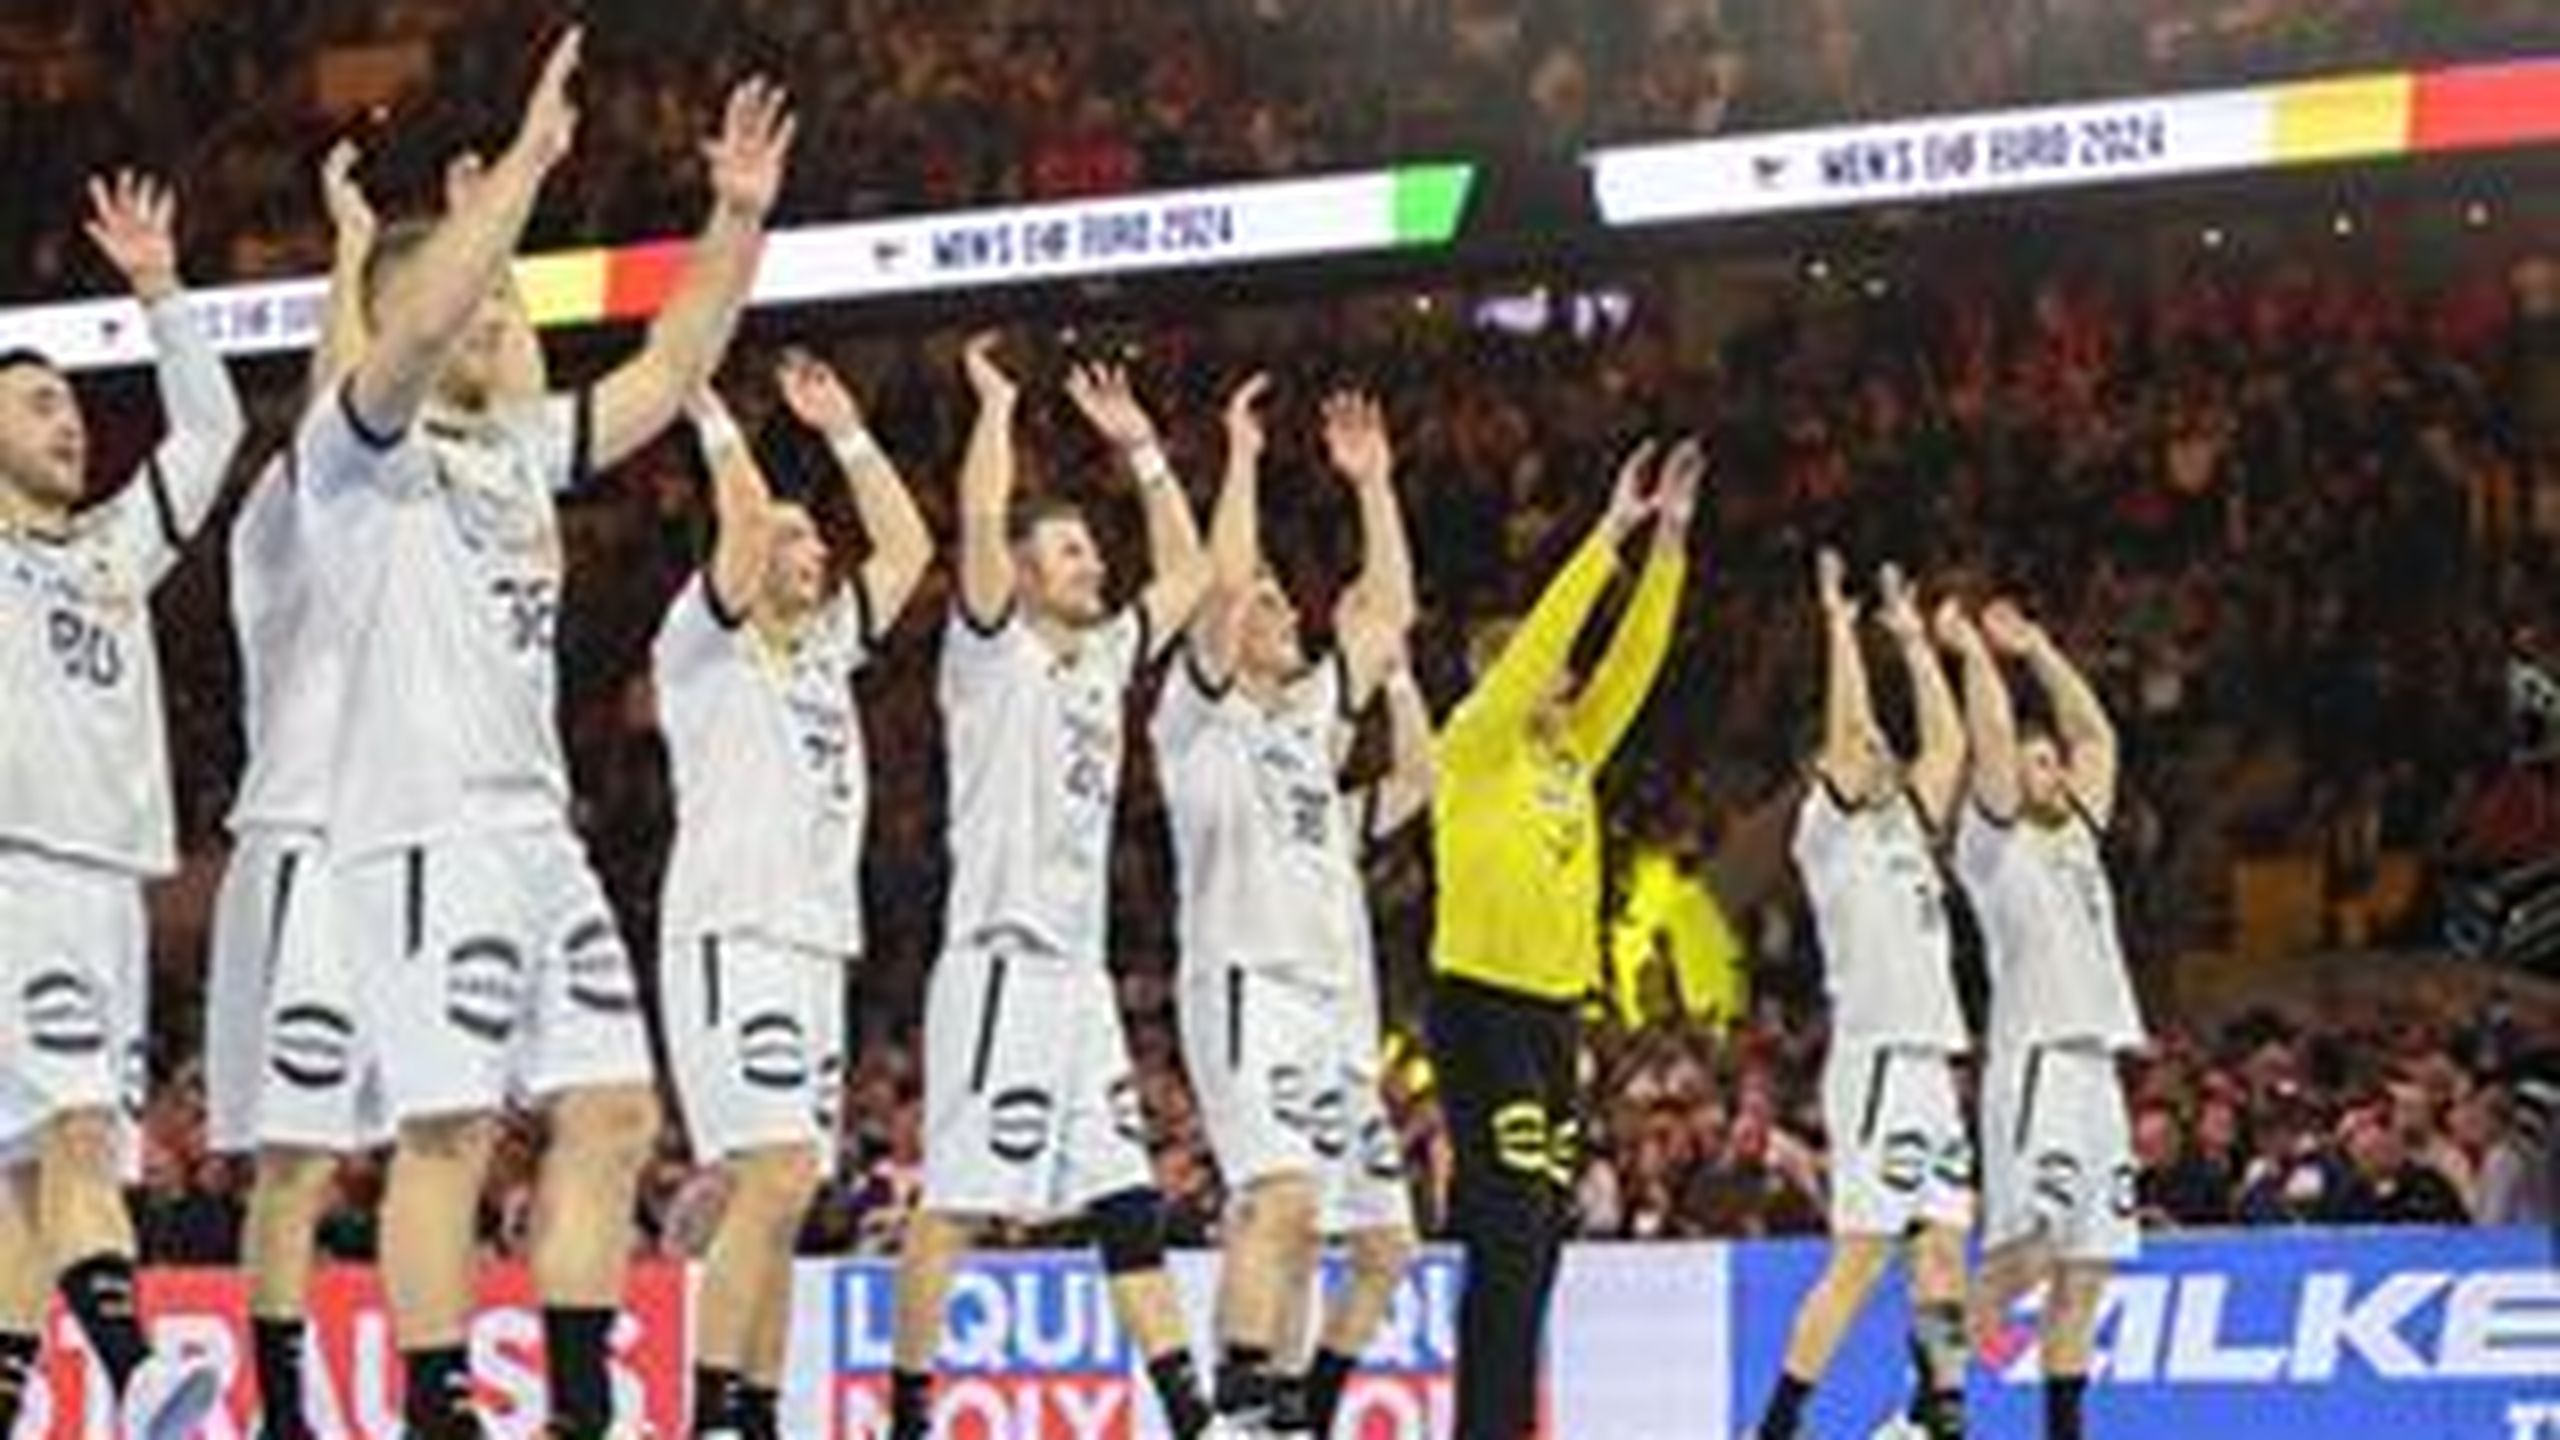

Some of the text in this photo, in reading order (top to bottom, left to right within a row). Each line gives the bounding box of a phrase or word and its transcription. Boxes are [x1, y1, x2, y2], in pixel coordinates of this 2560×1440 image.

[1988, 122, 2070, 173] EURO
[2080, 113, 2165, 166] 2024
[1080, 211, 1150, 256] EURO
[1159, 204, 1234, 250] 2024
